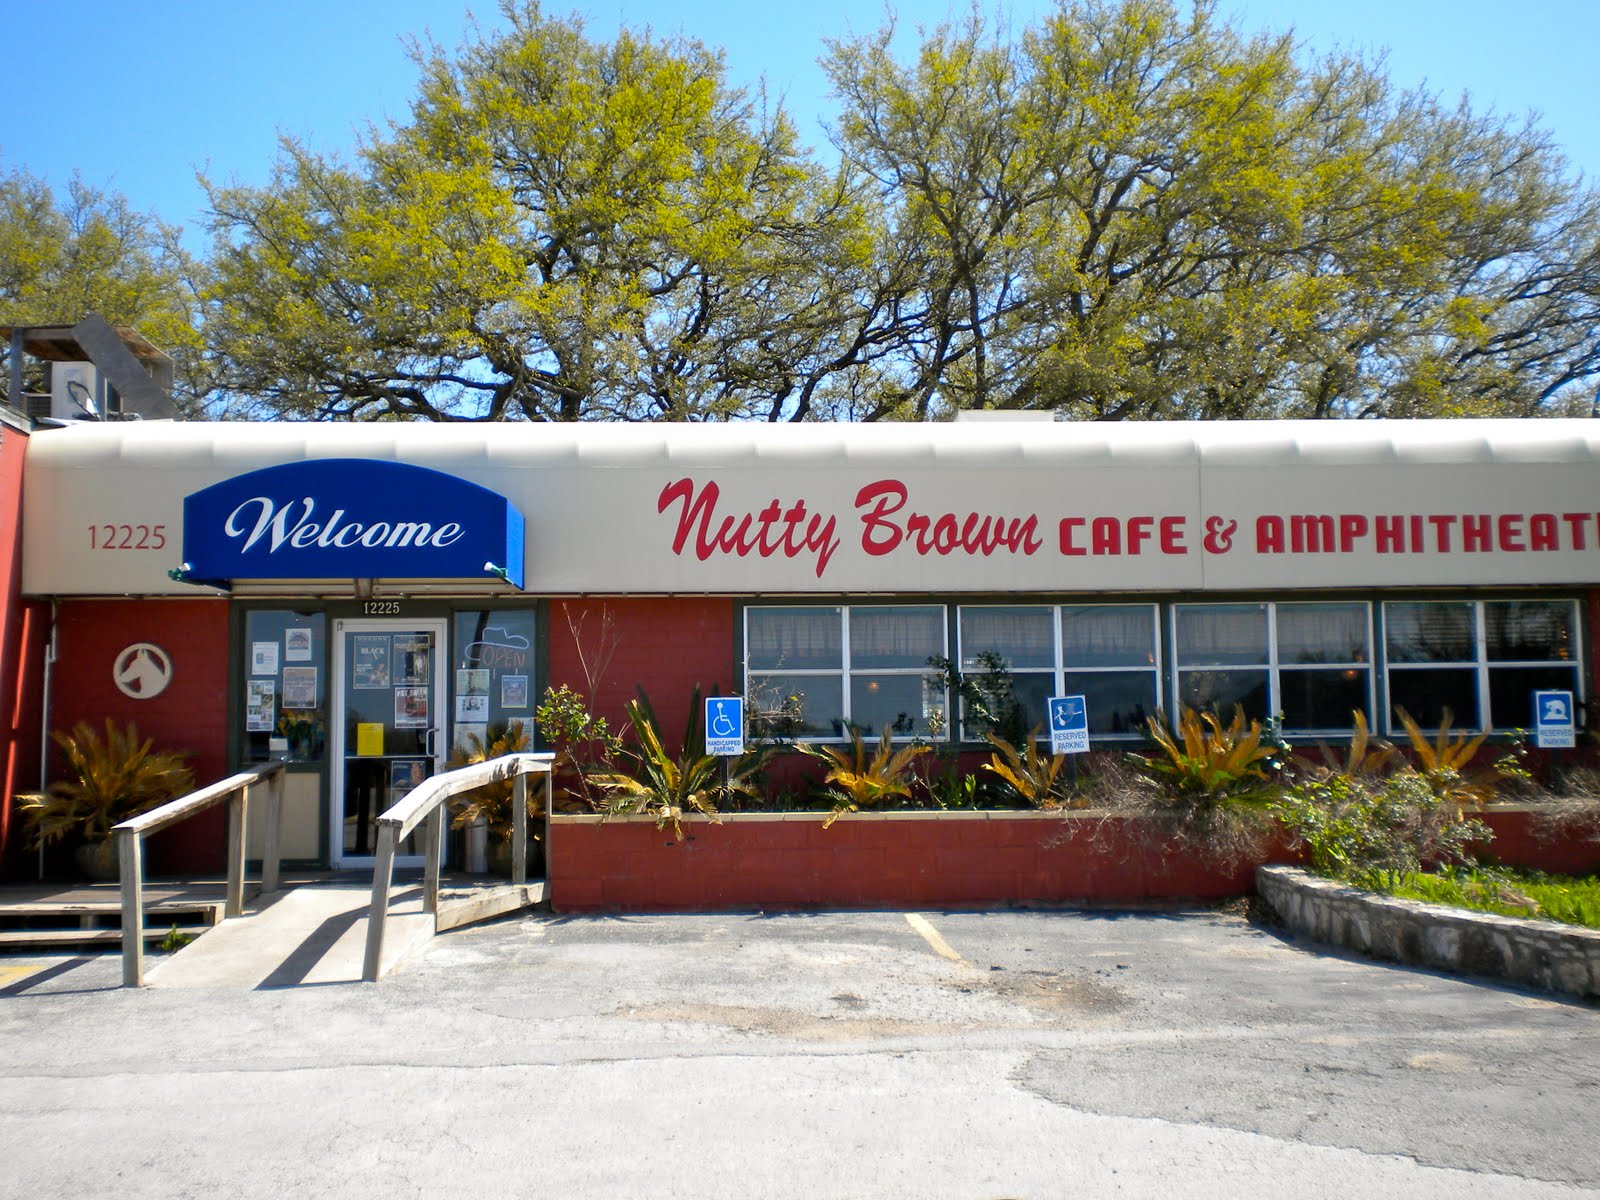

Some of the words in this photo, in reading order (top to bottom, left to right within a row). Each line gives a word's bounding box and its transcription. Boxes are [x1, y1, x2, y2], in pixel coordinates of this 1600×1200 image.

[224, 496, 466, 554] Welcome
[657, 477, 840, 578] Nutty
[854, 479, 1043, 556] Brown
[1059, 516, 1188, 555] CAFE
[1203, 515, 1238, 554] &
[1256, 512, 1600, 553] AMPHITHEAT
[87, 525, 166, 550] 12225
[364, 602, 400, 614] 12225
[361, 647, 385, 658] BLACK
[482, 645, 526, 668] OPEN
[1054, 731, 1086, 741] RESERVED
[1058, 741, 1085, 750] PARKING
